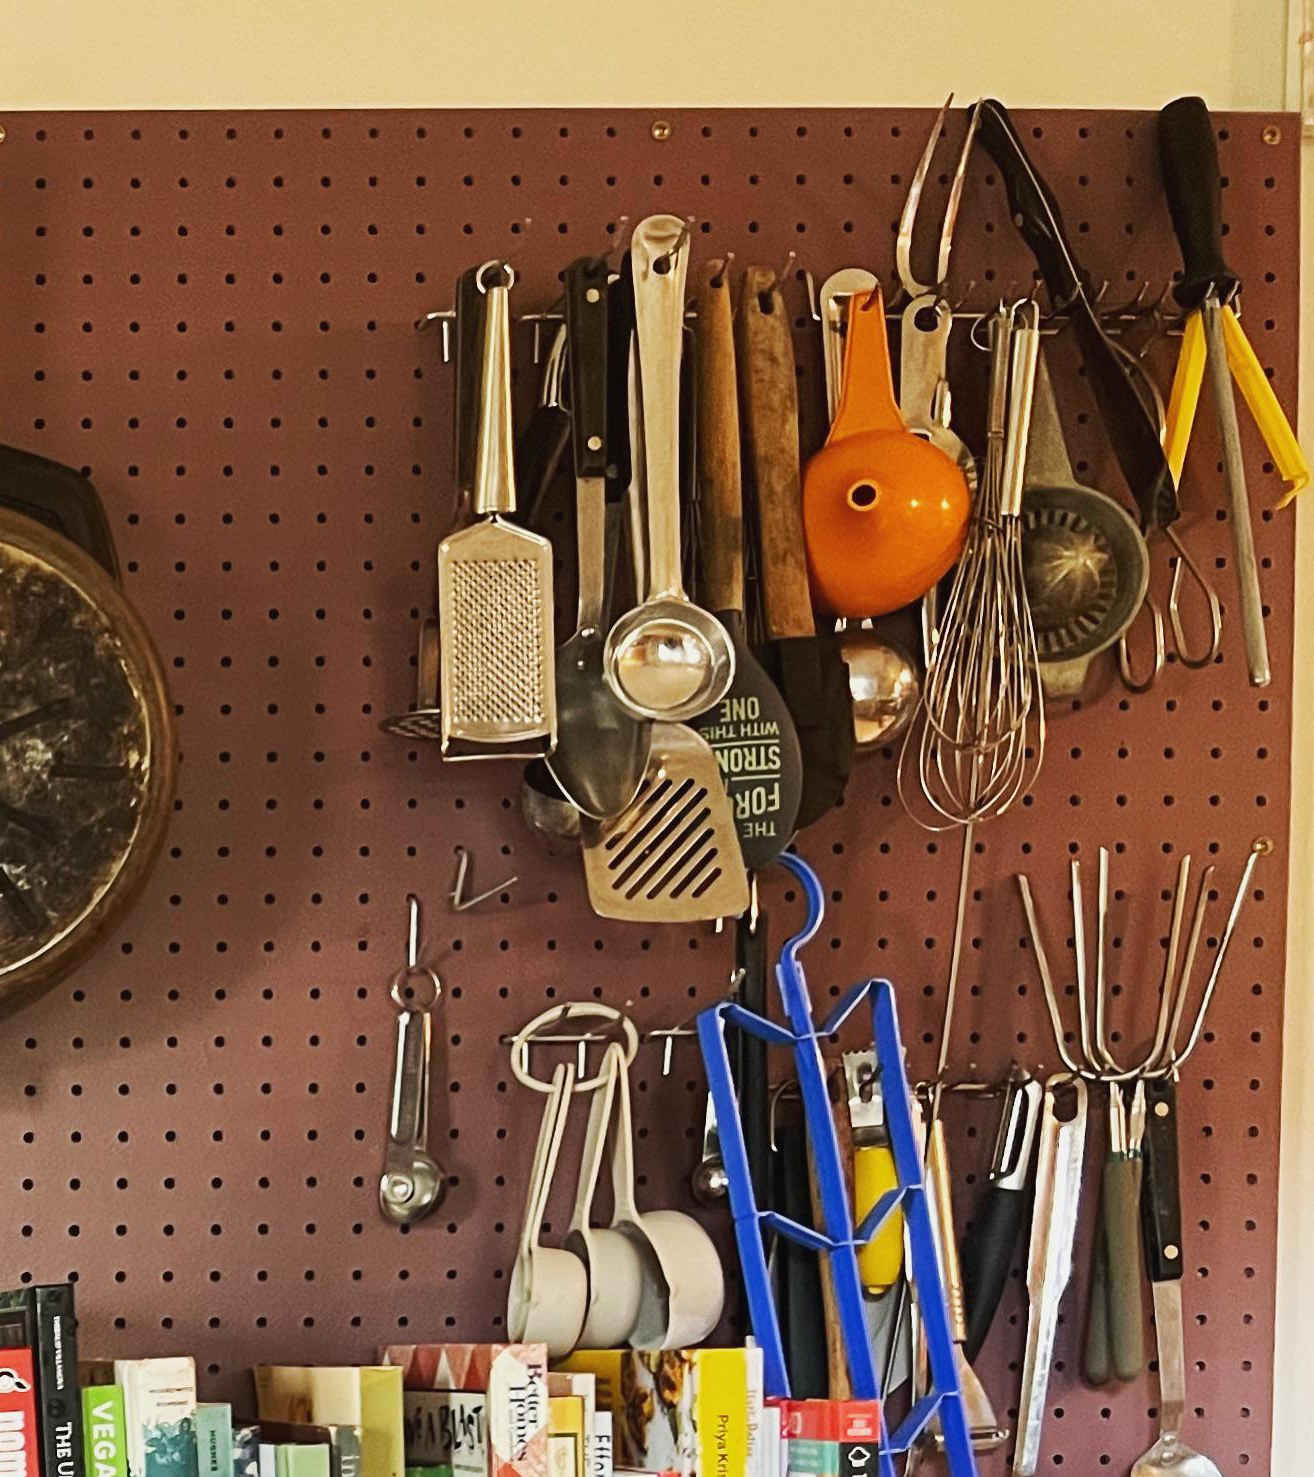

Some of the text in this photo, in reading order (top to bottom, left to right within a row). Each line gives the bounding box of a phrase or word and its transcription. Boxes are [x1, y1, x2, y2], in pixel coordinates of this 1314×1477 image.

[720, 697, 760, 722] ONE
[699, 721, 780, 740] WITH THIS
[714, 745, 781, 773] STRON
[736, 782, 780, 819] FOR
[743, 822, 776, 838] THE
[526, 1364, 542, 1423] Better
[55, 1422, 73, 1459] THE
[713, 1414, 729, 1450] Priya
